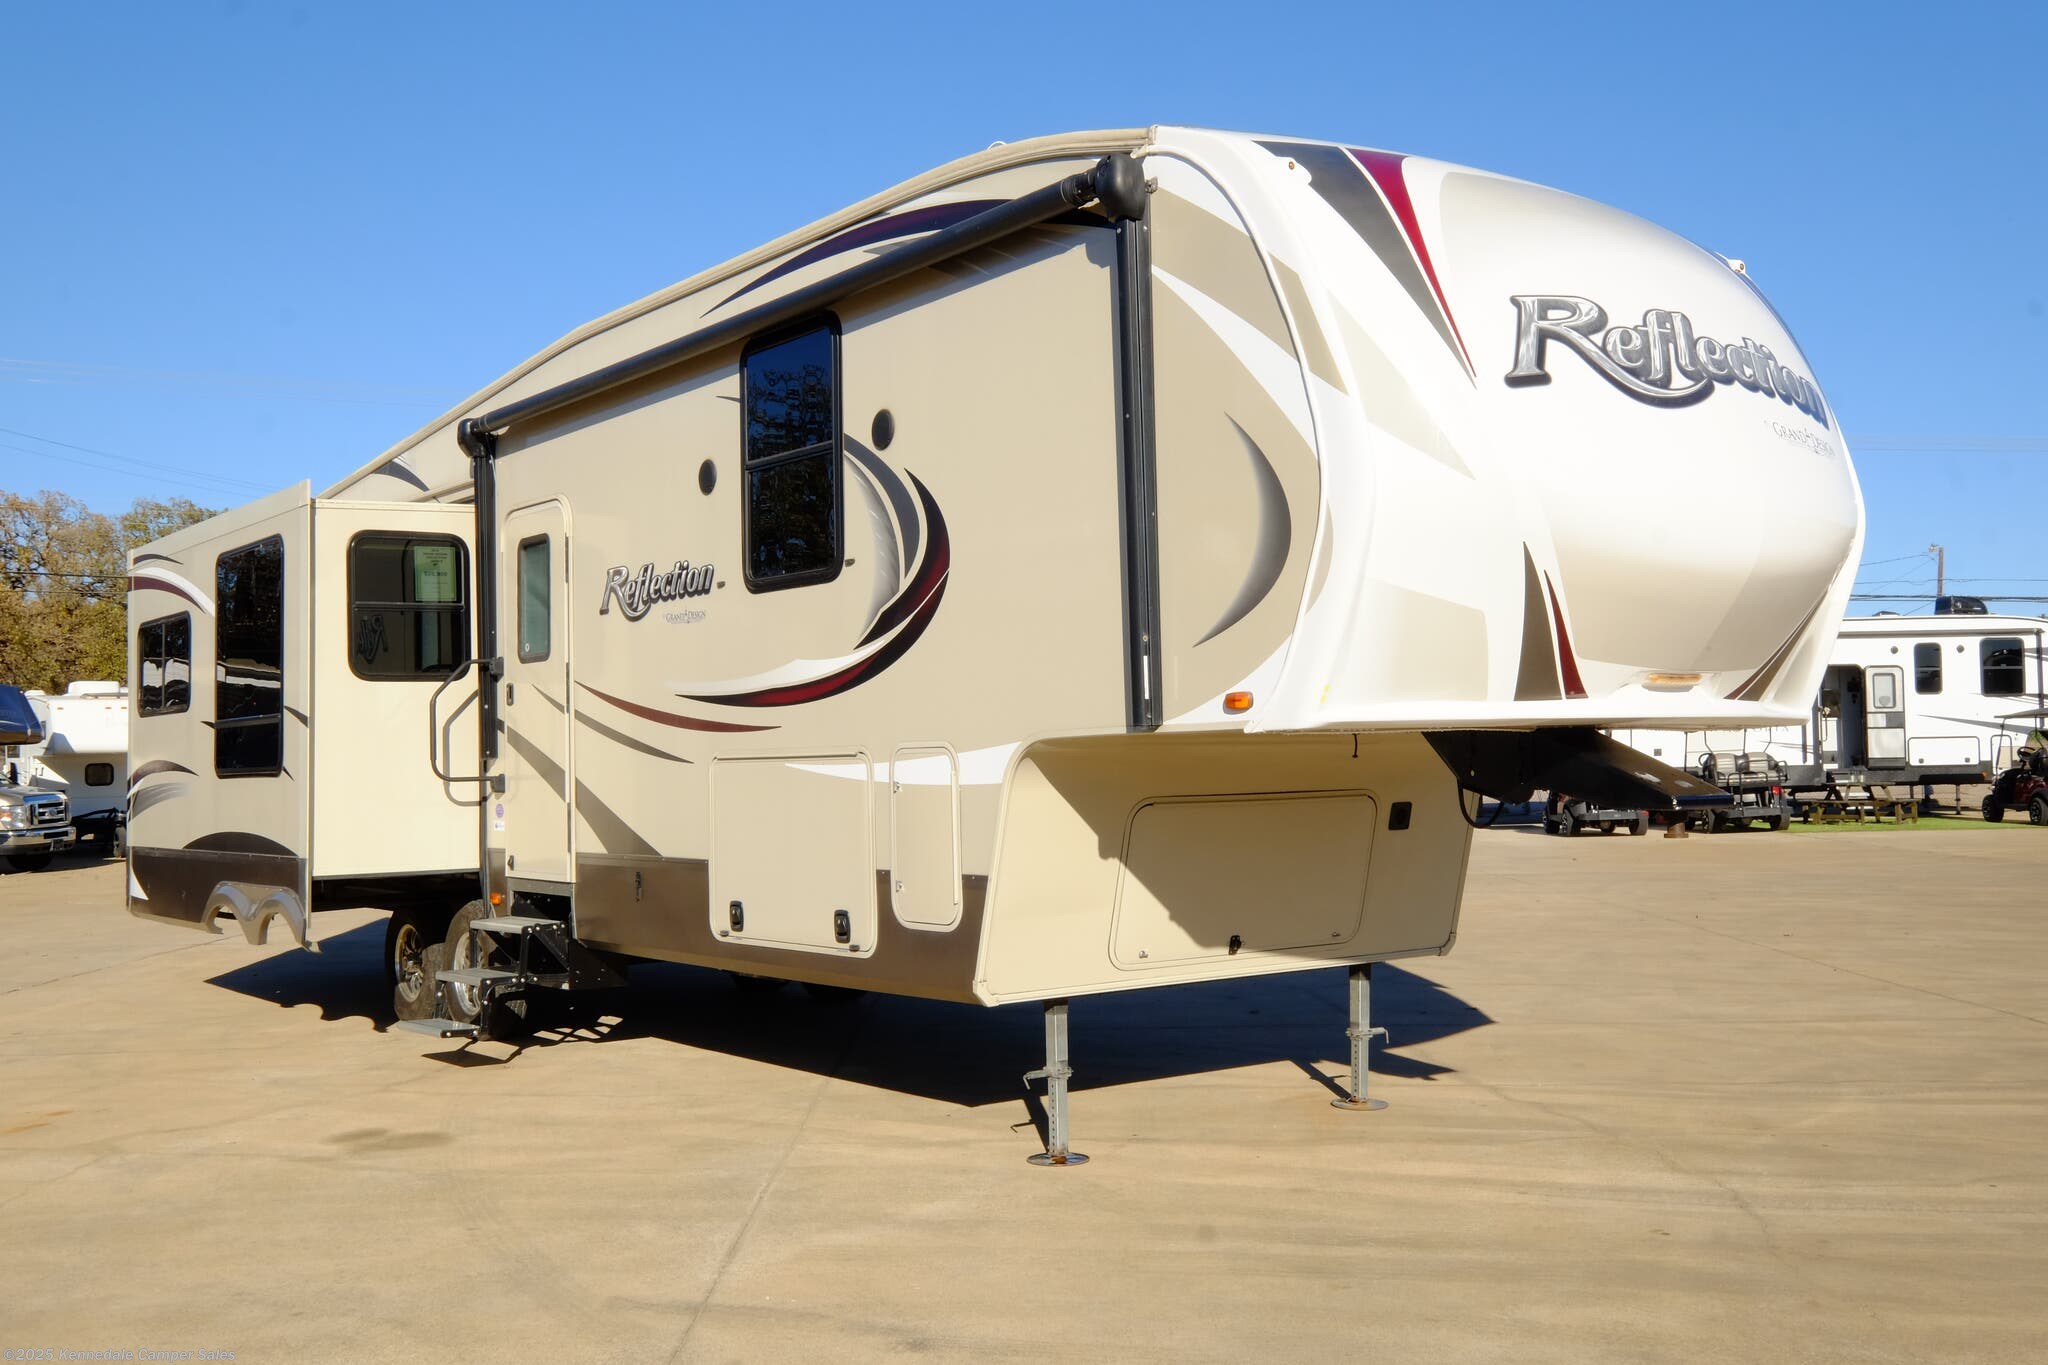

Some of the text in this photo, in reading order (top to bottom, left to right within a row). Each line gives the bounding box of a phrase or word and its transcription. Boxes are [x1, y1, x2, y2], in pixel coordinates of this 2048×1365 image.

[1504, 294, 1830, 430] Reflection
[1772, 421, 1807, 443] GRAND
[599, 559, 714, 622] Reflection
